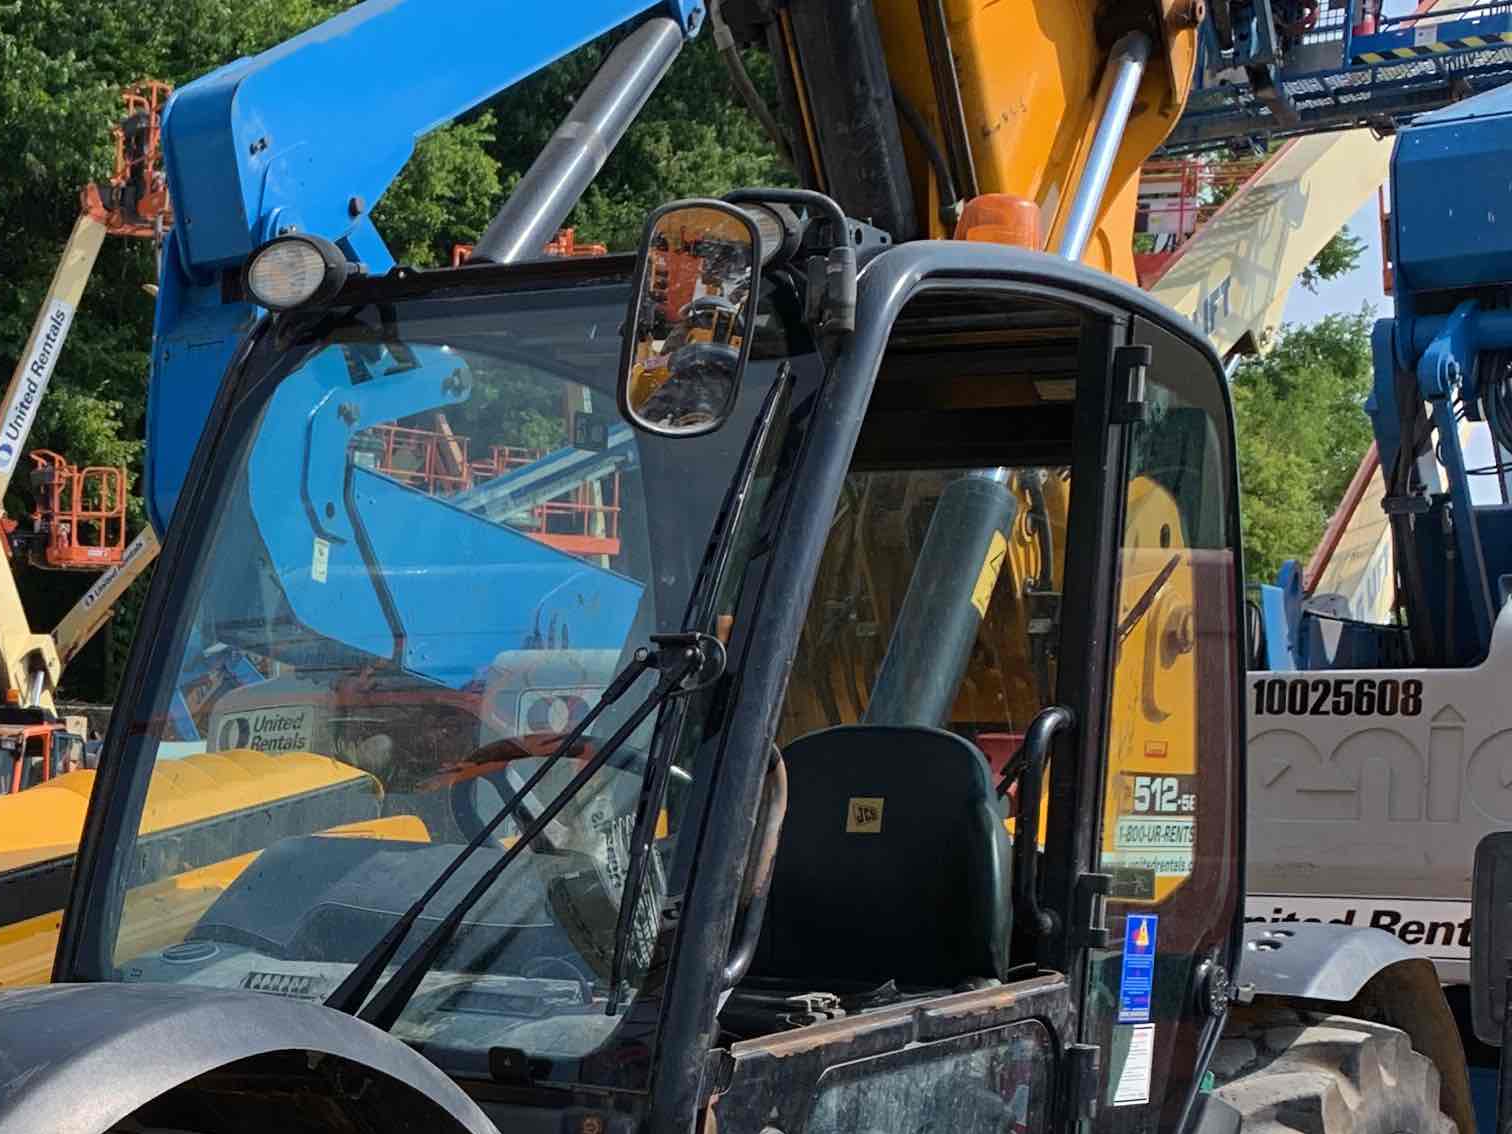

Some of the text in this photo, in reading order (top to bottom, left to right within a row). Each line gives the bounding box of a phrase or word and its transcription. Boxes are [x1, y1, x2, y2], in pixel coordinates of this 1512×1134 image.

[6, 308, 66, 442] United Rentals
[1253, 679, 1423, 716] 10025608
[254, 711, 304, 732] United
[251, 731, 305, 751] Rentals
[1369, 909, 1473, 951] Rent
